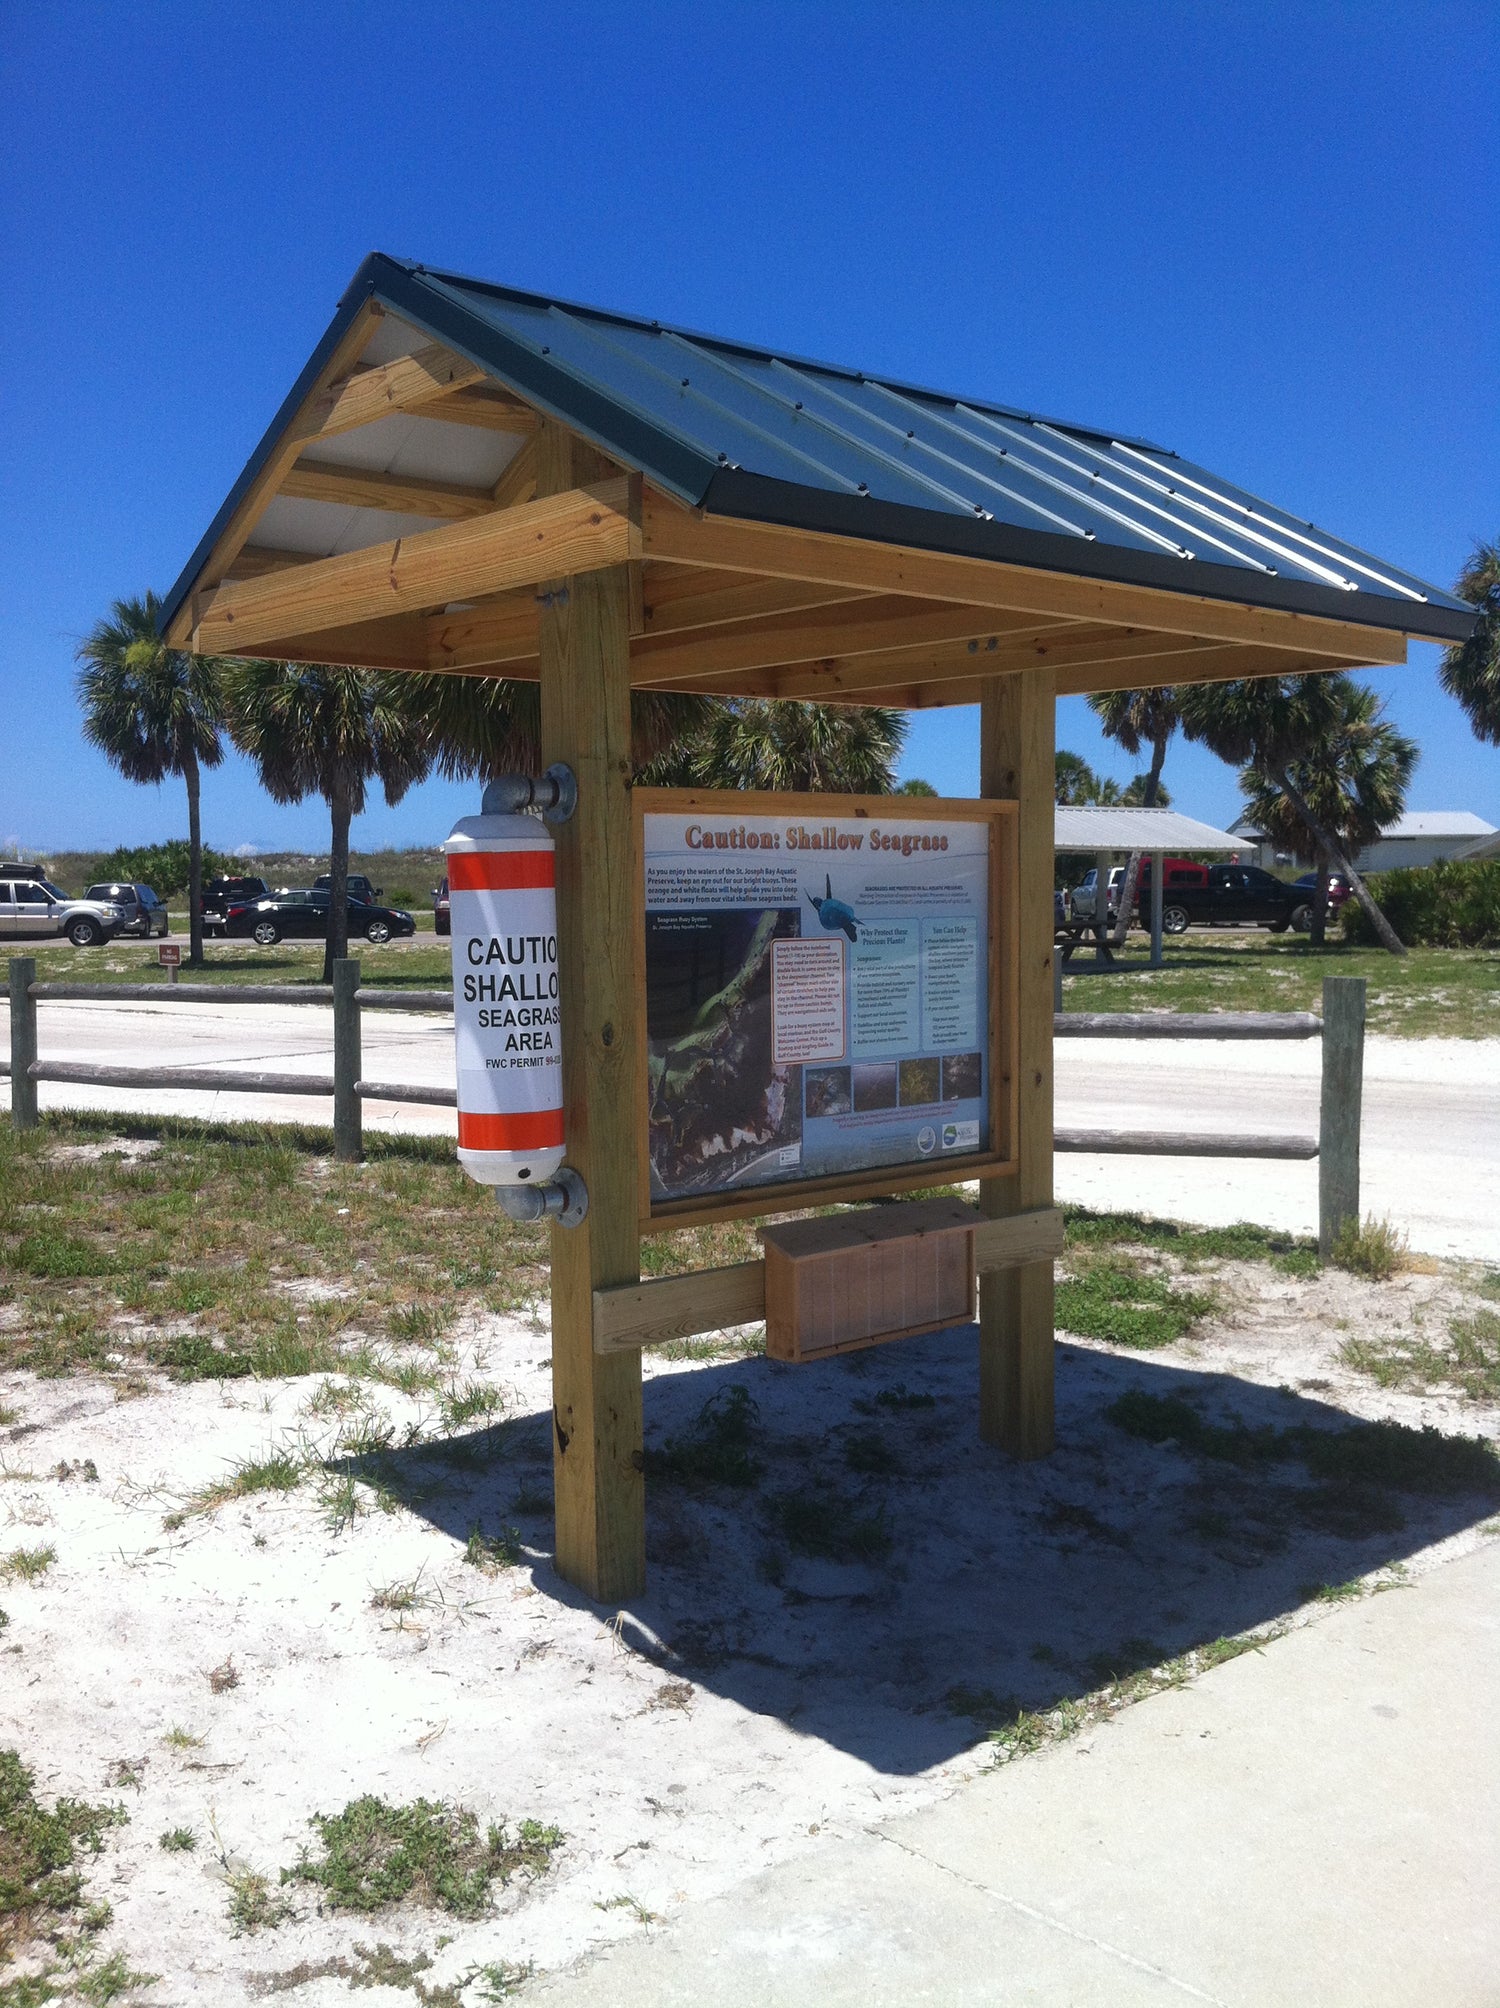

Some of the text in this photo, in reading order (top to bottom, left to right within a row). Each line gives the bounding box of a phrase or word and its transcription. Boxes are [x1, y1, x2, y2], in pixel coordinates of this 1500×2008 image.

[685, 825, 949, 856] Caution: Shallow Seagrass
[669, 868, 686, 876] enjoy
[745, 868, 764, 876] Joseph
[765, 868, 775, 876] Bay
[648, 877, 676, 885] Preserve,
[677, 877, 692, 885] keep
[744, 877, 761, 885] bright
[730, 886, 743, 894] help
[744, 886, 760, 894] guide
[468, 936, 559, 965] CAUTIO
[464, 972, 559, 1002] SHALLO
[505, 1031, 553, 1051] AREA
[486, 1058, 508, 1069] FWC
[510, 1057, 544, 1068] PERMIT
